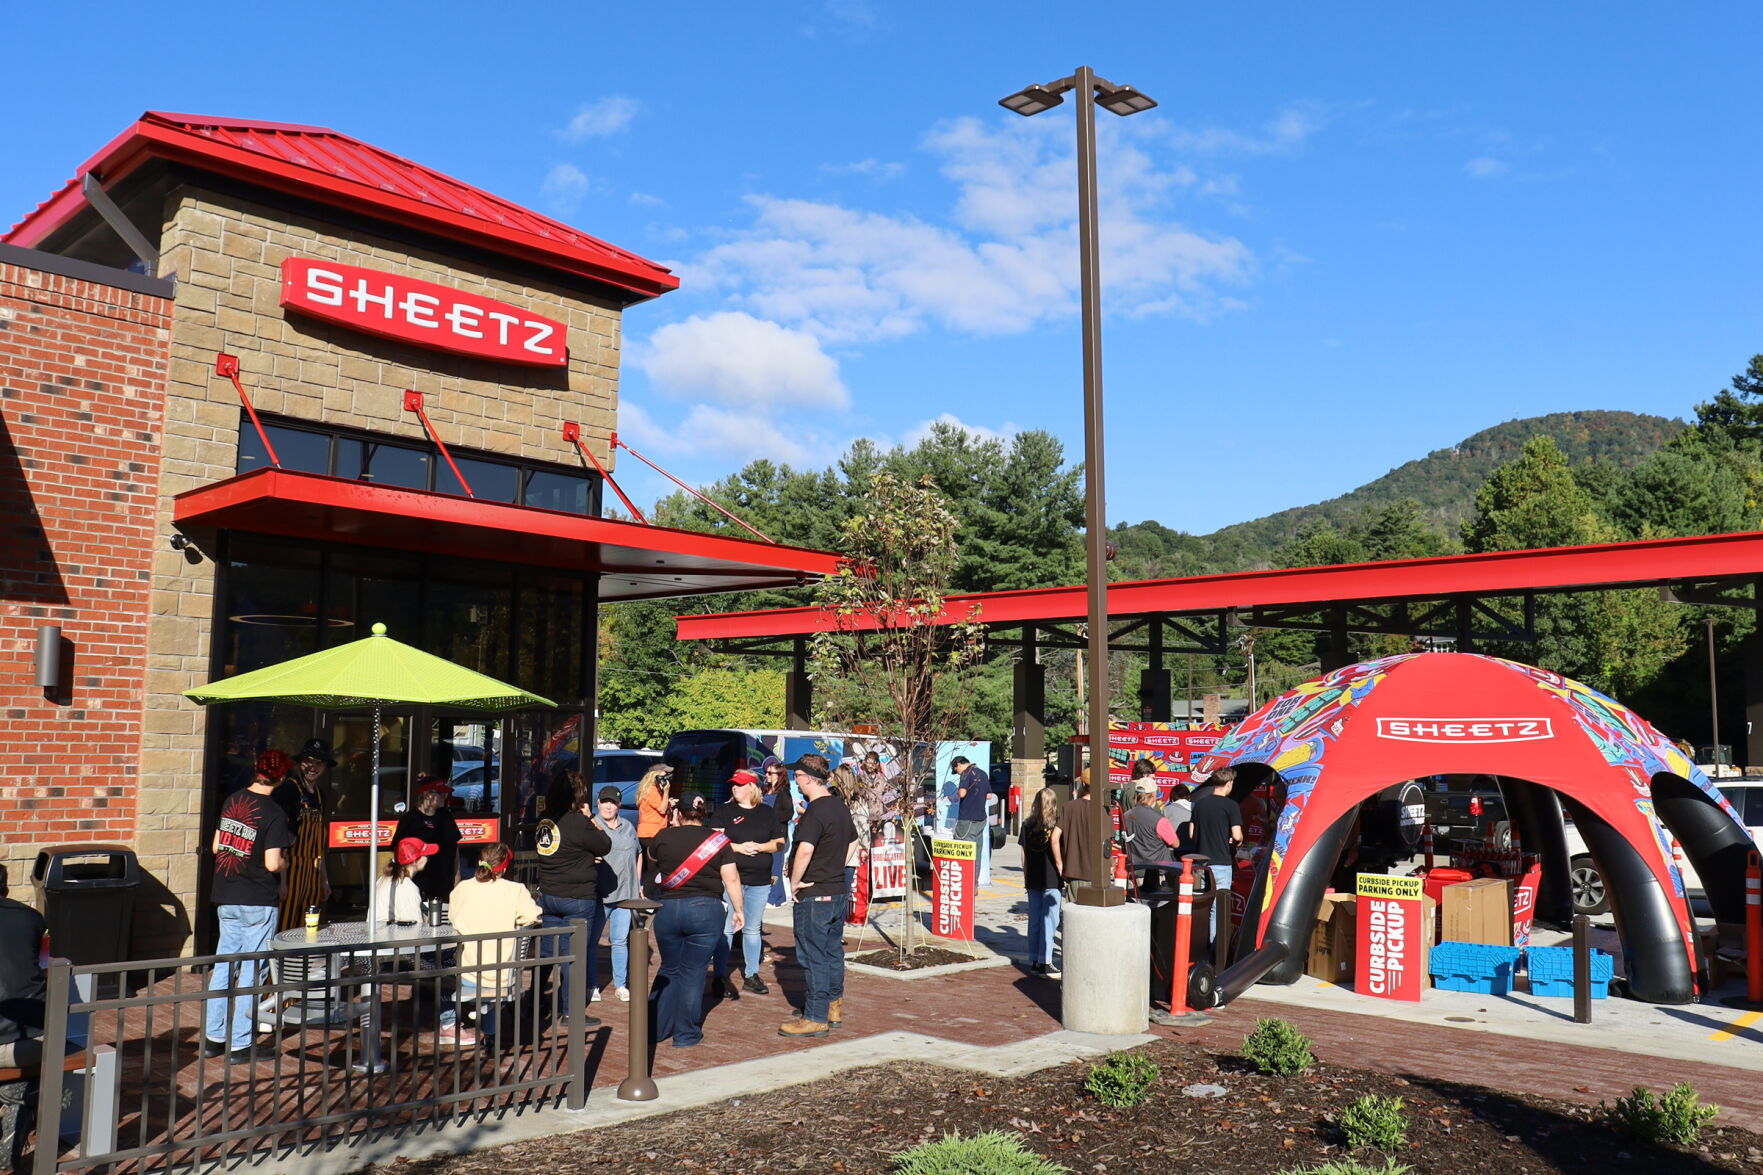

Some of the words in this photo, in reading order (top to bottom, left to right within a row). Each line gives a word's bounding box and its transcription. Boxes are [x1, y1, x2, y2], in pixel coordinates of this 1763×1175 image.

[306, 268, 553, 355] SHEETZ
[1266, 704, 1296, 721] ONE
[1390, 722, 1540, 737] SHEETZ
[346, 829, 391, 838] SHETZ
[459, 827, 484, 835] EETZ
[934, 841, 953, 849] CURBSIDE
[934, 847, 954, 857] PARKING
[956, 849, 973, 857] ONLY
[873, 864, 908, 890] LIVE
[1359, 876, 1390, 886] CURBSIDE
[1392, 879, 1419, 887] PICKUP
[950, 861, 963, 916] PICKUP
[1359, 884, 1393, 896] PARKING
[1395, 888, 1419, 896] ONLY
[940, 860, 949, 935] CURBSIDE
[1386, 901, 1405, 971] PICKUP
[1369, 900, 1386, 994] CURBSIDE
